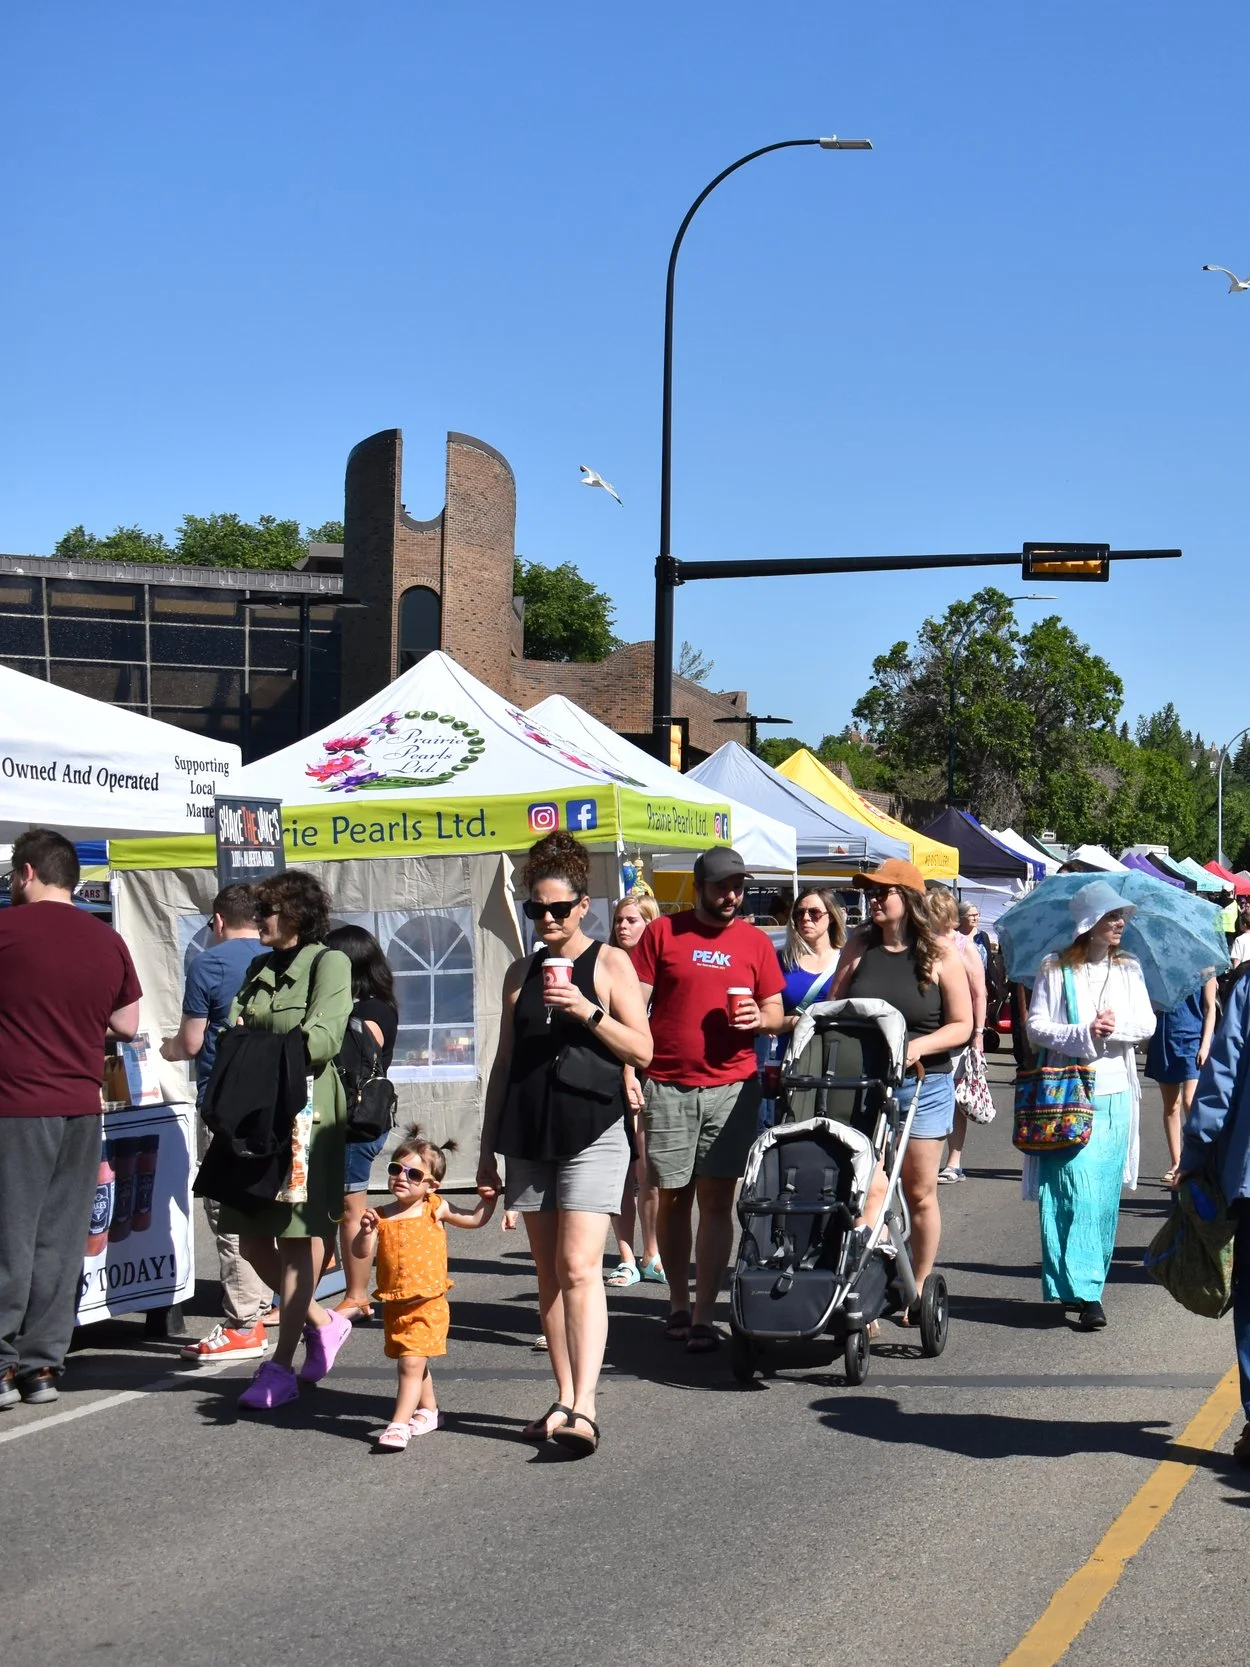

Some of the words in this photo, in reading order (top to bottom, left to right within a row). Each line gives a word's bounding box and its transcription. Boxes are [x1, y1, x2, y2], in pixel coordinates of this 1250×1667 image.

[386, 728, 464, 745] Prairie
[382, 744, 453, 760] Pearls
[1, 756, 57, 782] Owned
[62, 763, 92, 785] And
[96, 767, 159, 793] Operated
[174, 755, 230, 777] Supporting
[190, 780, 216, 796] Local
[186, 802, 215, 819] Matte
[672, 807, 694, 835] Pearls
[219, 805, 244, 845] SHAKE
[241, 805, 259, 846] THE
[257, 807, 280, 846] JAKE'S
[282, 819, 318, 848] rie
[331, 812, 423, 845] Pearls
[435, 808, 496, 840] Ltd.
[692, 949, 732, 967] PEAK
[98, 1254, 175, 1291] TODAY!
